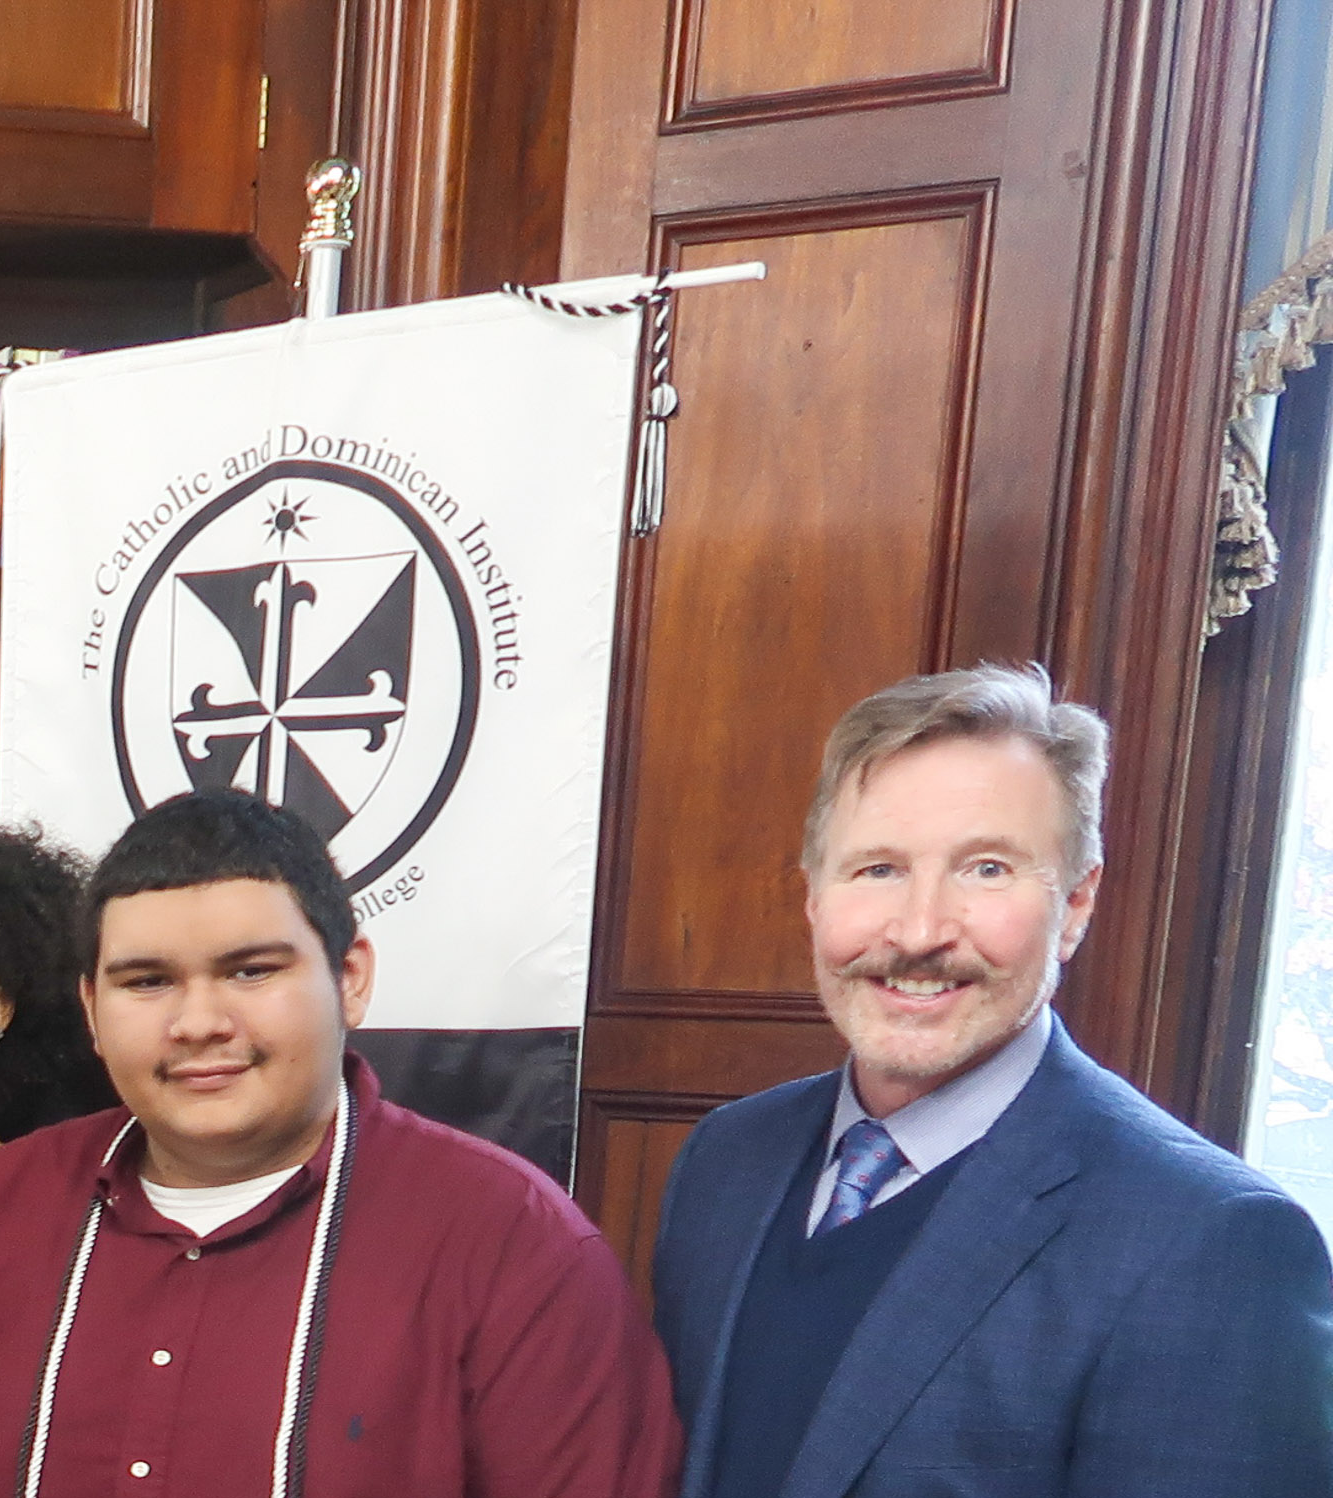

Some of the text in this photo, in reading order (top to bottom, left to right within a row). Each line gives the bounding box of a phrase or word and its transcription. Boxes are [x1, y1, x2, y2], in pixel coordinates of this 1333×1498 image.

[221, 429, 272, 482] and
[278, 424, 461, 527] Dominican
[93, 471, 213, 596] Catholic
[82, 608, 106, 680] The
[457, 517, 525, 691] Institute
[352, 865, 425, 925] ollege
